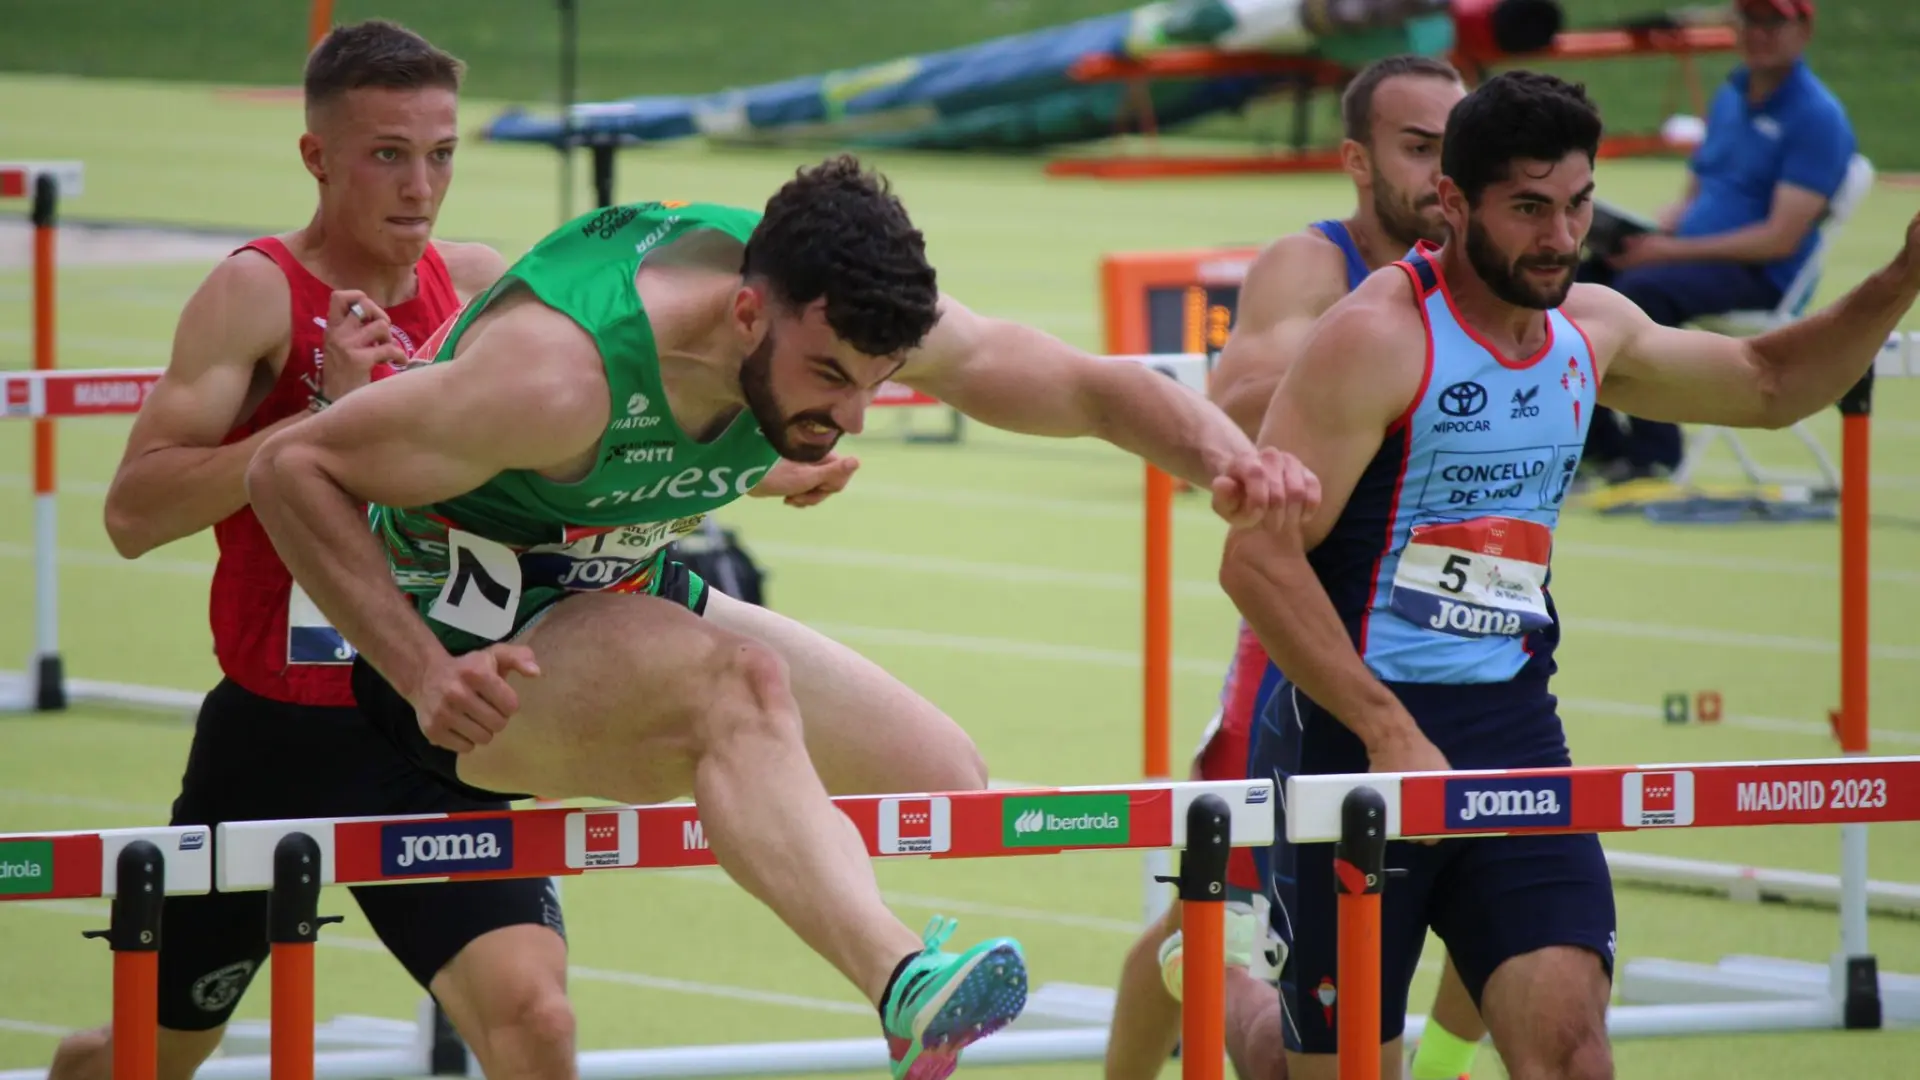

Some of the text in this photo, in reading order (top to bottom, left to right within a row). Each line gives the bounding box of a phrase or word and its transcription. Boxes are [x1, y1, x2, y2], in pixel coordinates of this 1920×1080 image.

[1510, 405, 1540, 419] ZICO
[1431, 420, 1491, 434] NIPOCAR
[1442, 460, 1545, 483] CONCELLO
[1448, 489, 1480, 505] DE
[446, 546, 512, 611] 7
[1439, 554, 1471, 594] 5
[1737, 778, 1888, 812] MADRID 2023
[1046, 812, 1120, 831] Iberdrola
